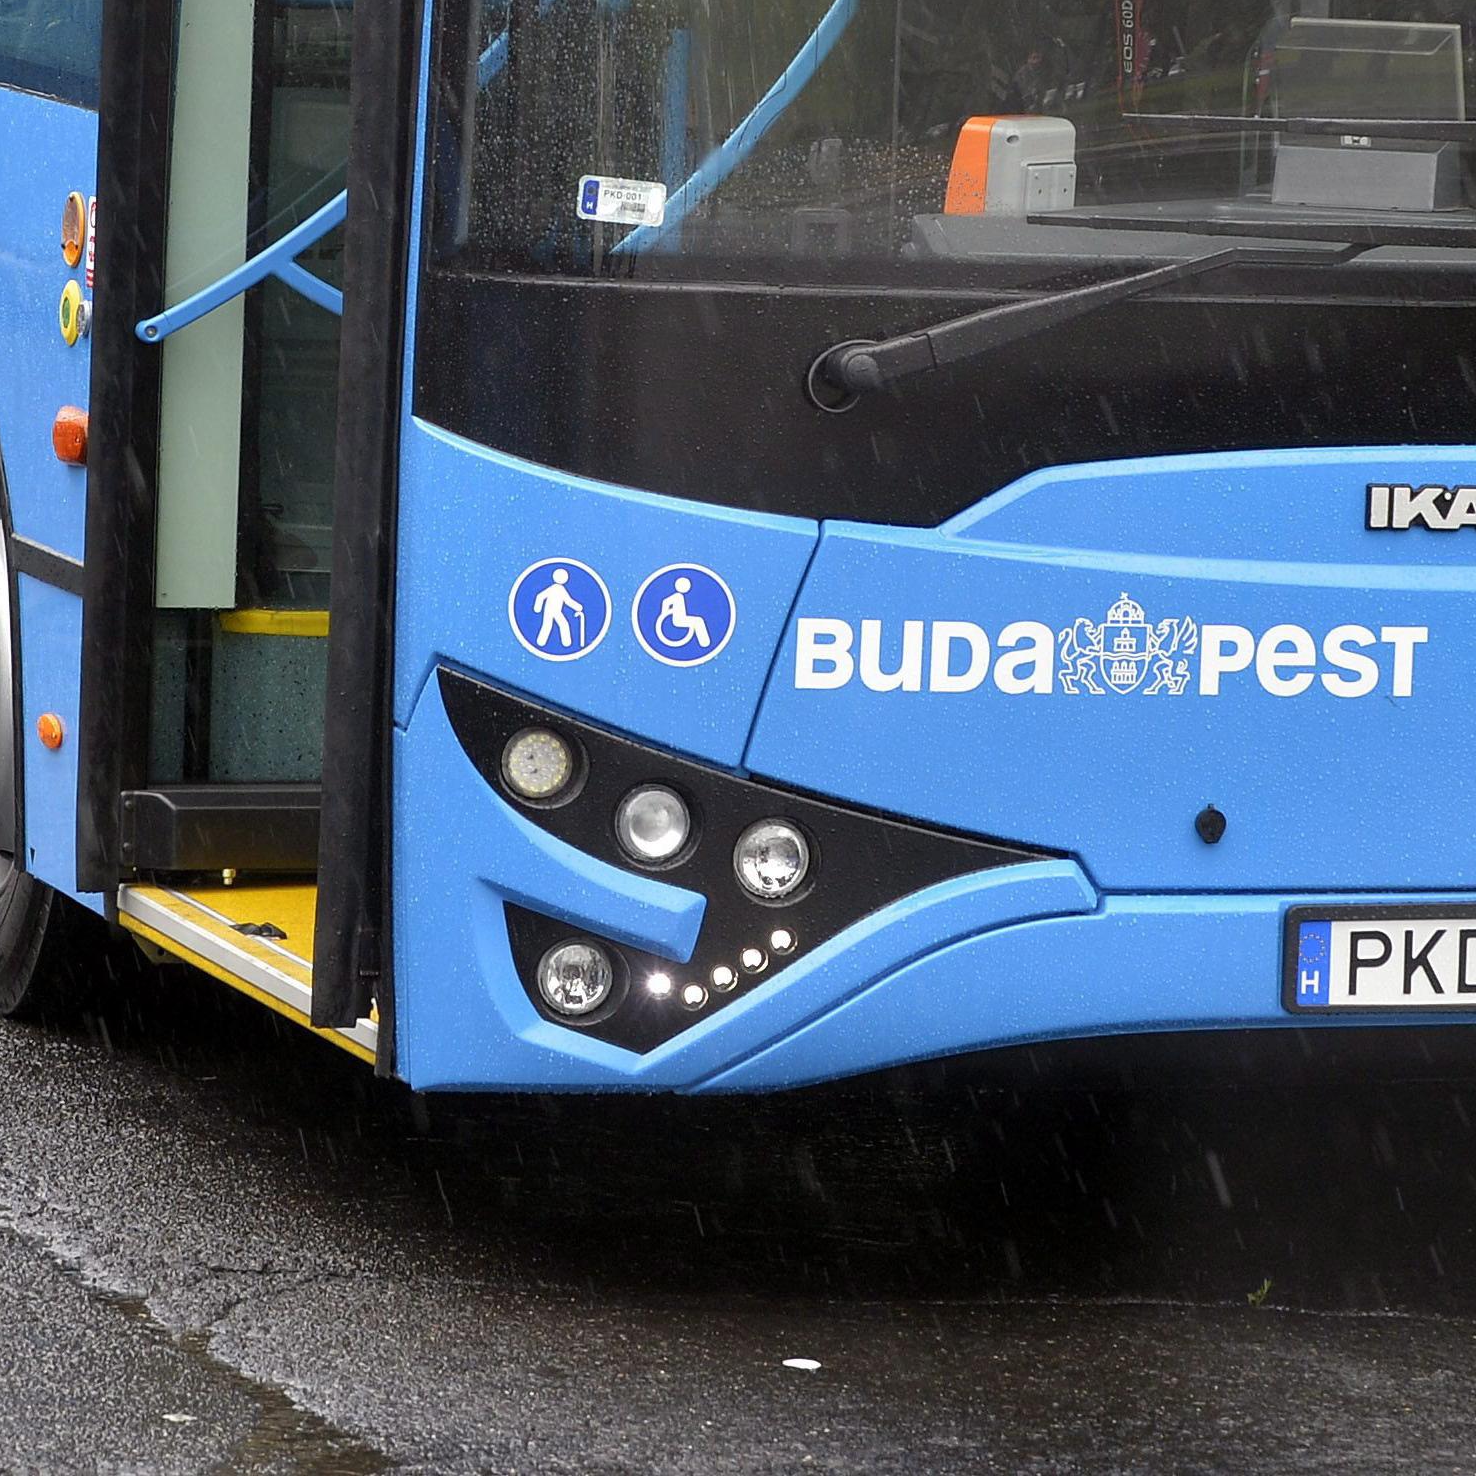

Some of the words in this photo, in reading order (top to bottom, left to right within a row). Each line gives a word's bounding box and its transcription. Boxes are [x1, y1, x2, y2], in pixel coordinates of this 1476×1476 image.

[1121, 0, 1134, 28] 60D
[1123, 33, 1133, 74] EOS
[1300, 970, 1320, 995] H
